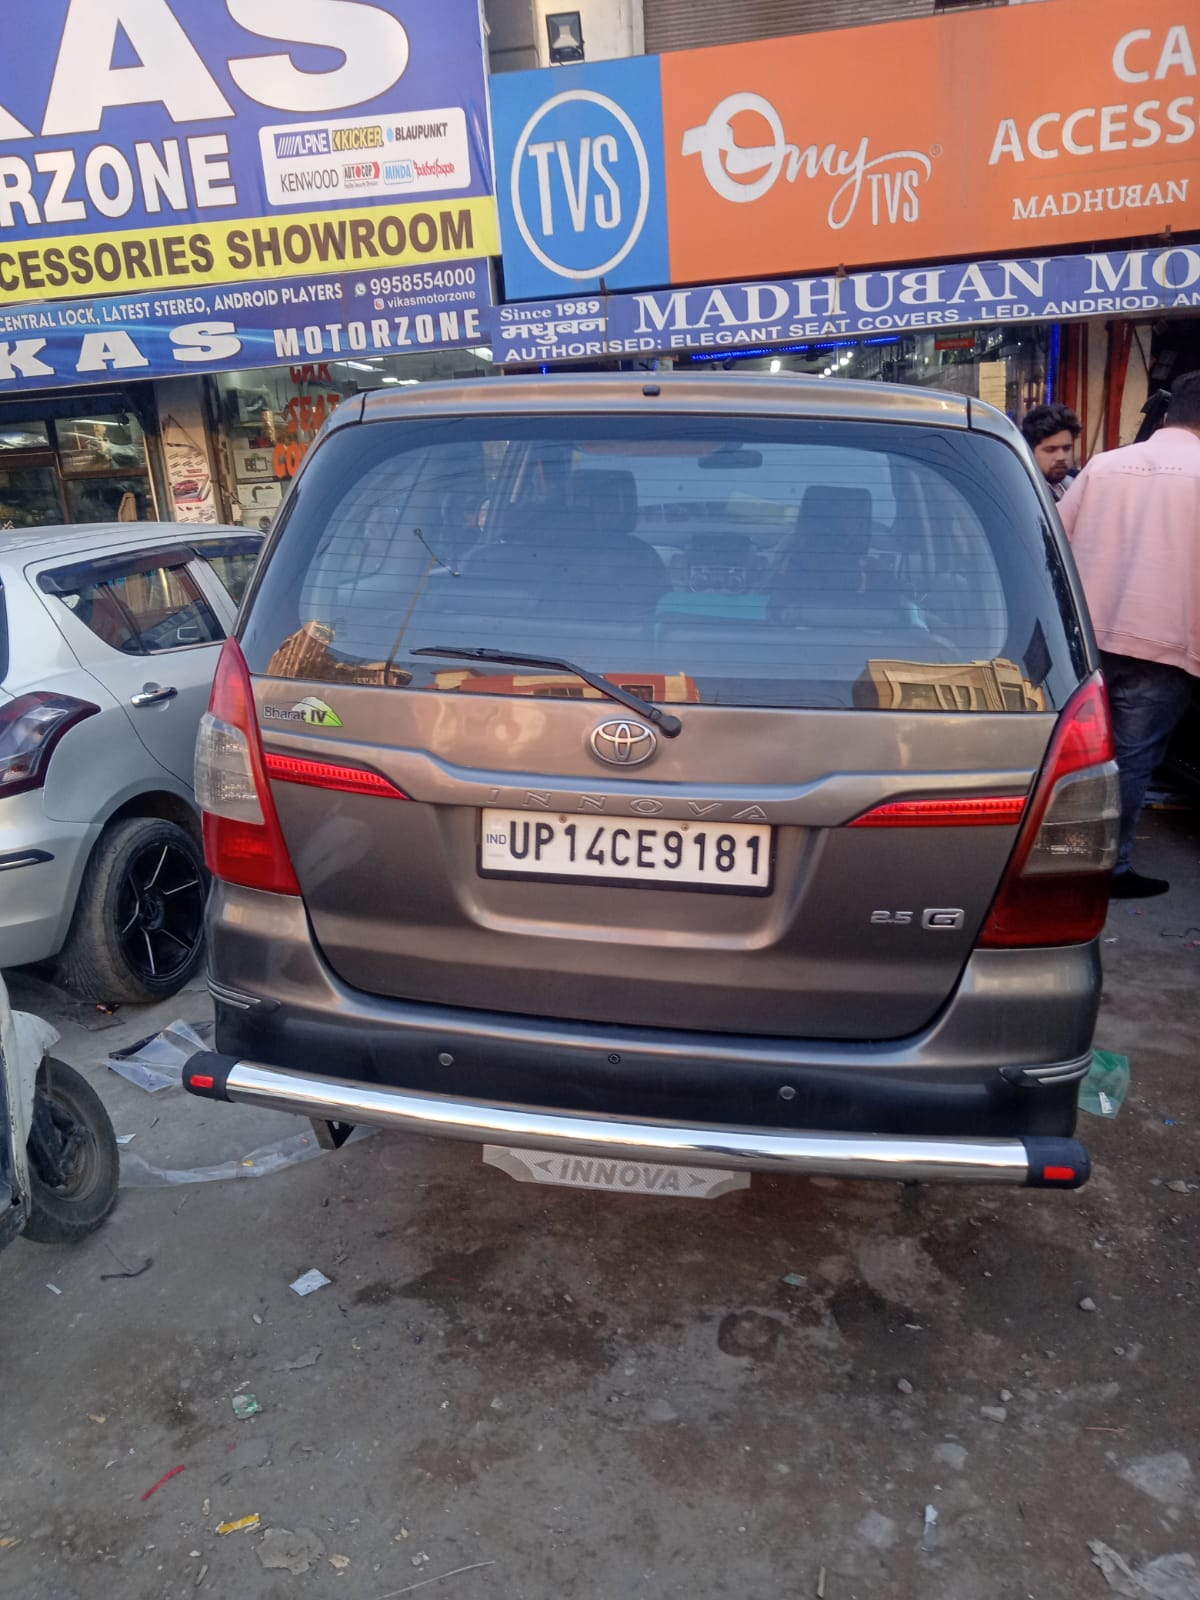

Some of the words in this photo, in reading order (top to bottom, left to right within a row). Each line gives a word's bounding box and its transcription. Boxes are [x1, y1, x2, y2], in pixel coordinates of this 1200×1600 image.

[0, 0, 410, 140] AS
[1112, 25, 1197, 83] CA
[339, 127, 384, 151] KICKER
[395, 123, 448, 142] BLAUPUNKT
[988, 96, 1200, 165] ACCESS
[0, 134, 237, 227] RZONE
[280, 168, 339, 193] KENWOOD
[528, 135, 621, 236] TVS
[867, 169, 919, 225] TVS
[0, 233, 214, 291] CESSORIES
[227, 209, 475, 269] SHOWROOM
[0, 311, 57, 332] CENTRAL
[58, 307, 101, 326] LOCK,
[103, 302, 151, 322] LATEST
[154, 296, 211, 317] STEREO,
[214, 286, 279, 312] ANDROID
[281, 282, 343, 305] PLAYERS
[370, 267, 476, 296] 9958554000
[387, 289, 476, 310] vikasmotorzone
[272, 307, 481, 358] MOTORZONE
[499, 308, 552, 322] Since
[555, 300, 601, 317] 1989
[505, 337, 662, 362] AUTHORISED:
[670, 327, 782, 348] ELEGANT
[788, 319, 850, 338] SEAT
[857, 309, 960, 331] COVERS
[981, 303, 1036, 319] LED,
[263, 705, 306, 720] Bharat
[311, 709, 327, 723] IV
[486, 788, 769, 821] INNOVA
[486, 833, 507, 845] IND
[509, 820, 761, 875] UP14CE9181
[559, 1158, 681, 1192] INNOVA
